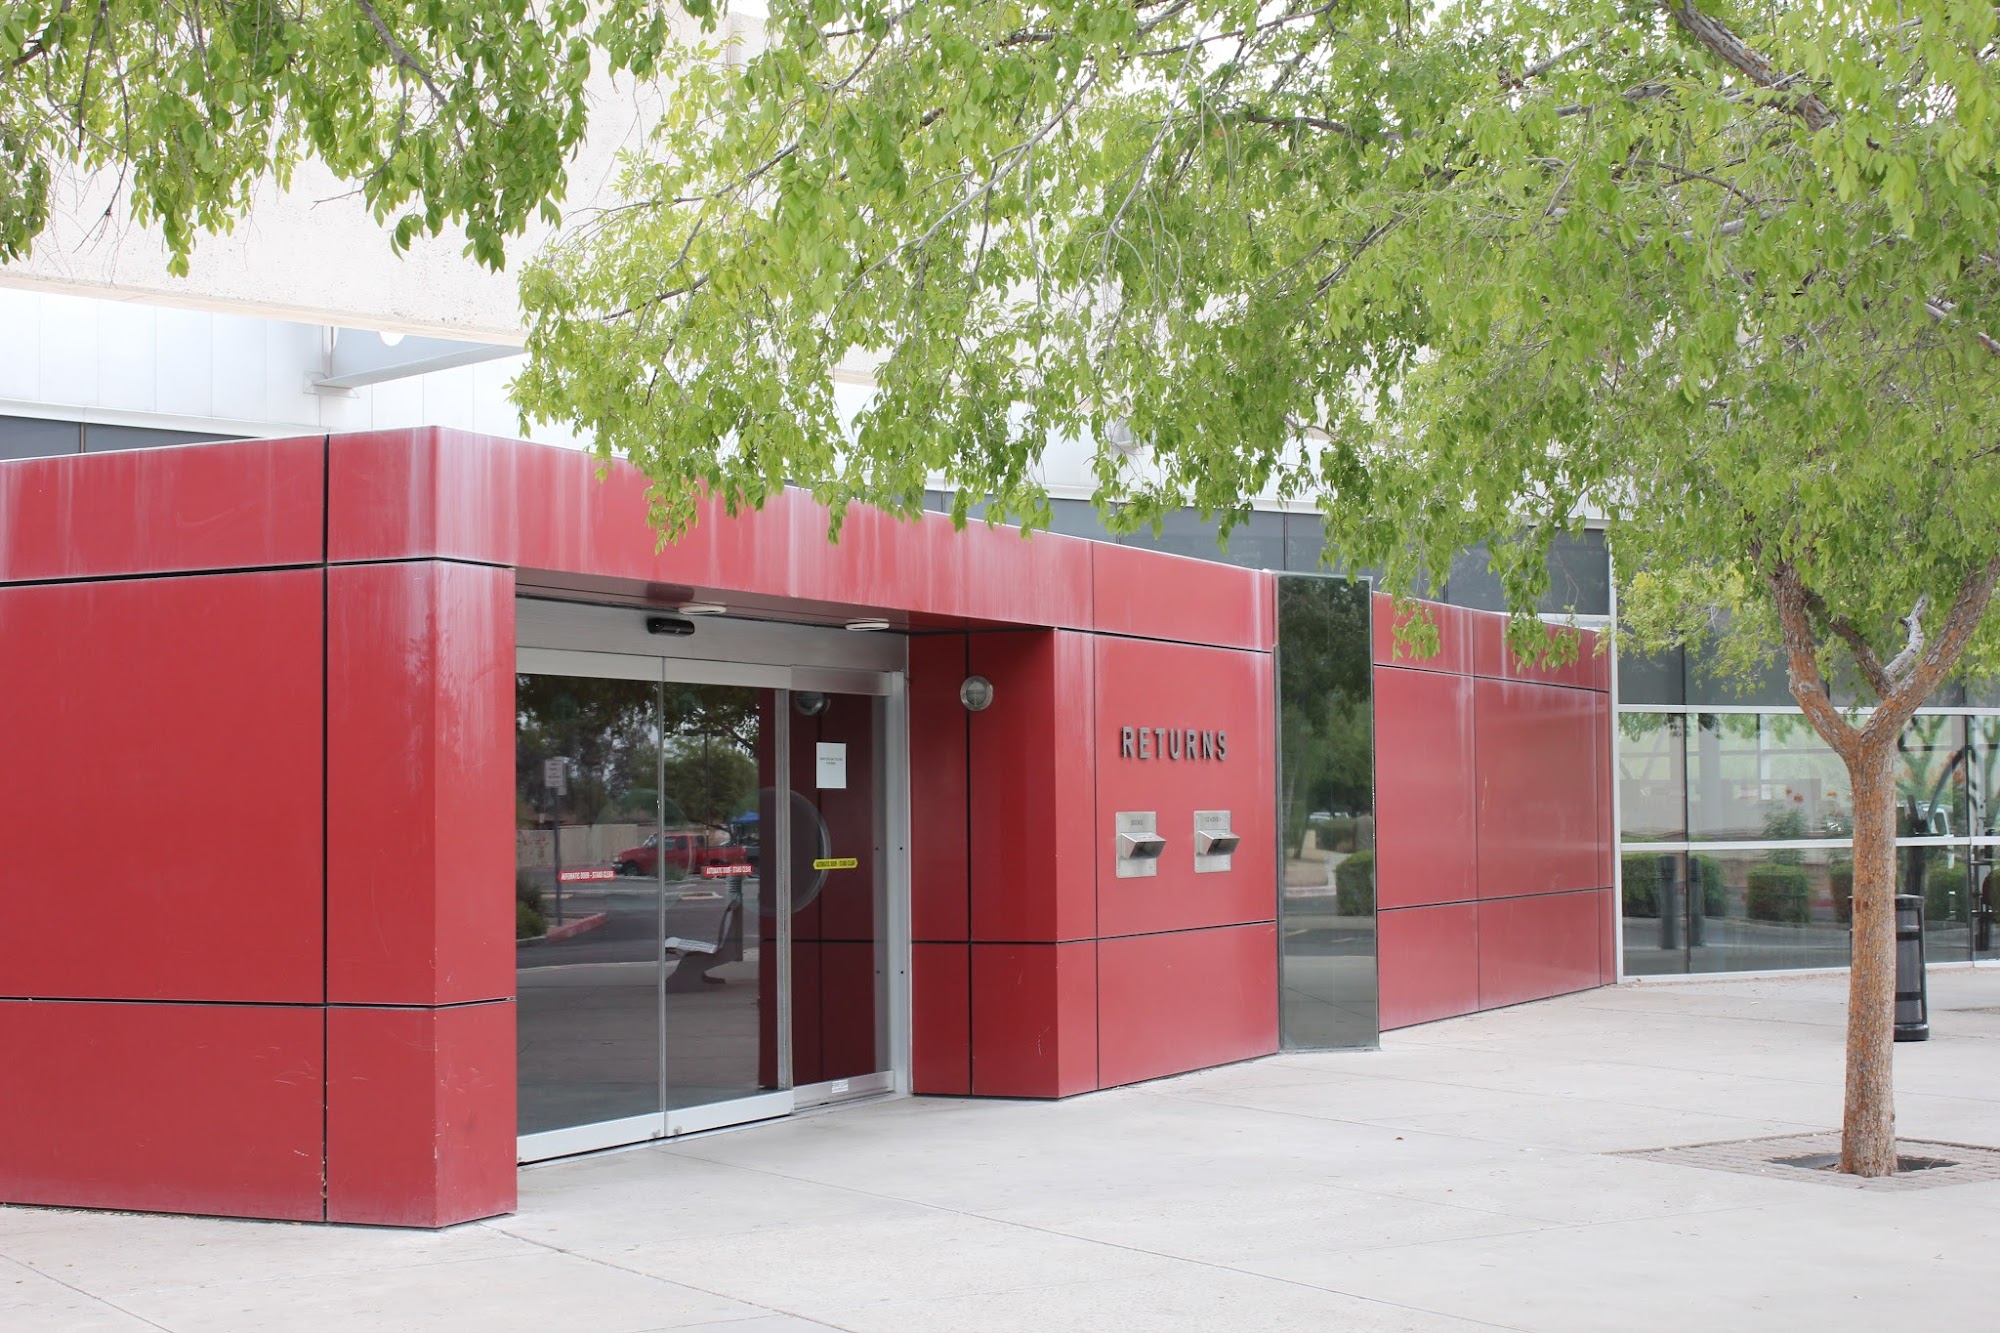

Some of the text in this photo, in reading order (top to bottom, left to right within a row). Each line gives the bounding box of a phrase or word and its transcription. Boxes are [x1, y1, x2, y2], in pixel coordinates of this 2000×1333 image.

[1120, 726, 1227, 761] RETURNS
[561, 872, 580, 880] AUTOMATIC
[580, 871, 590, 879] DOOR
[592, 871, 603, 879] STAND
[603, 870, 614, 878] CLEAR
[706, 866, 723, 875] AUTOMATIC
